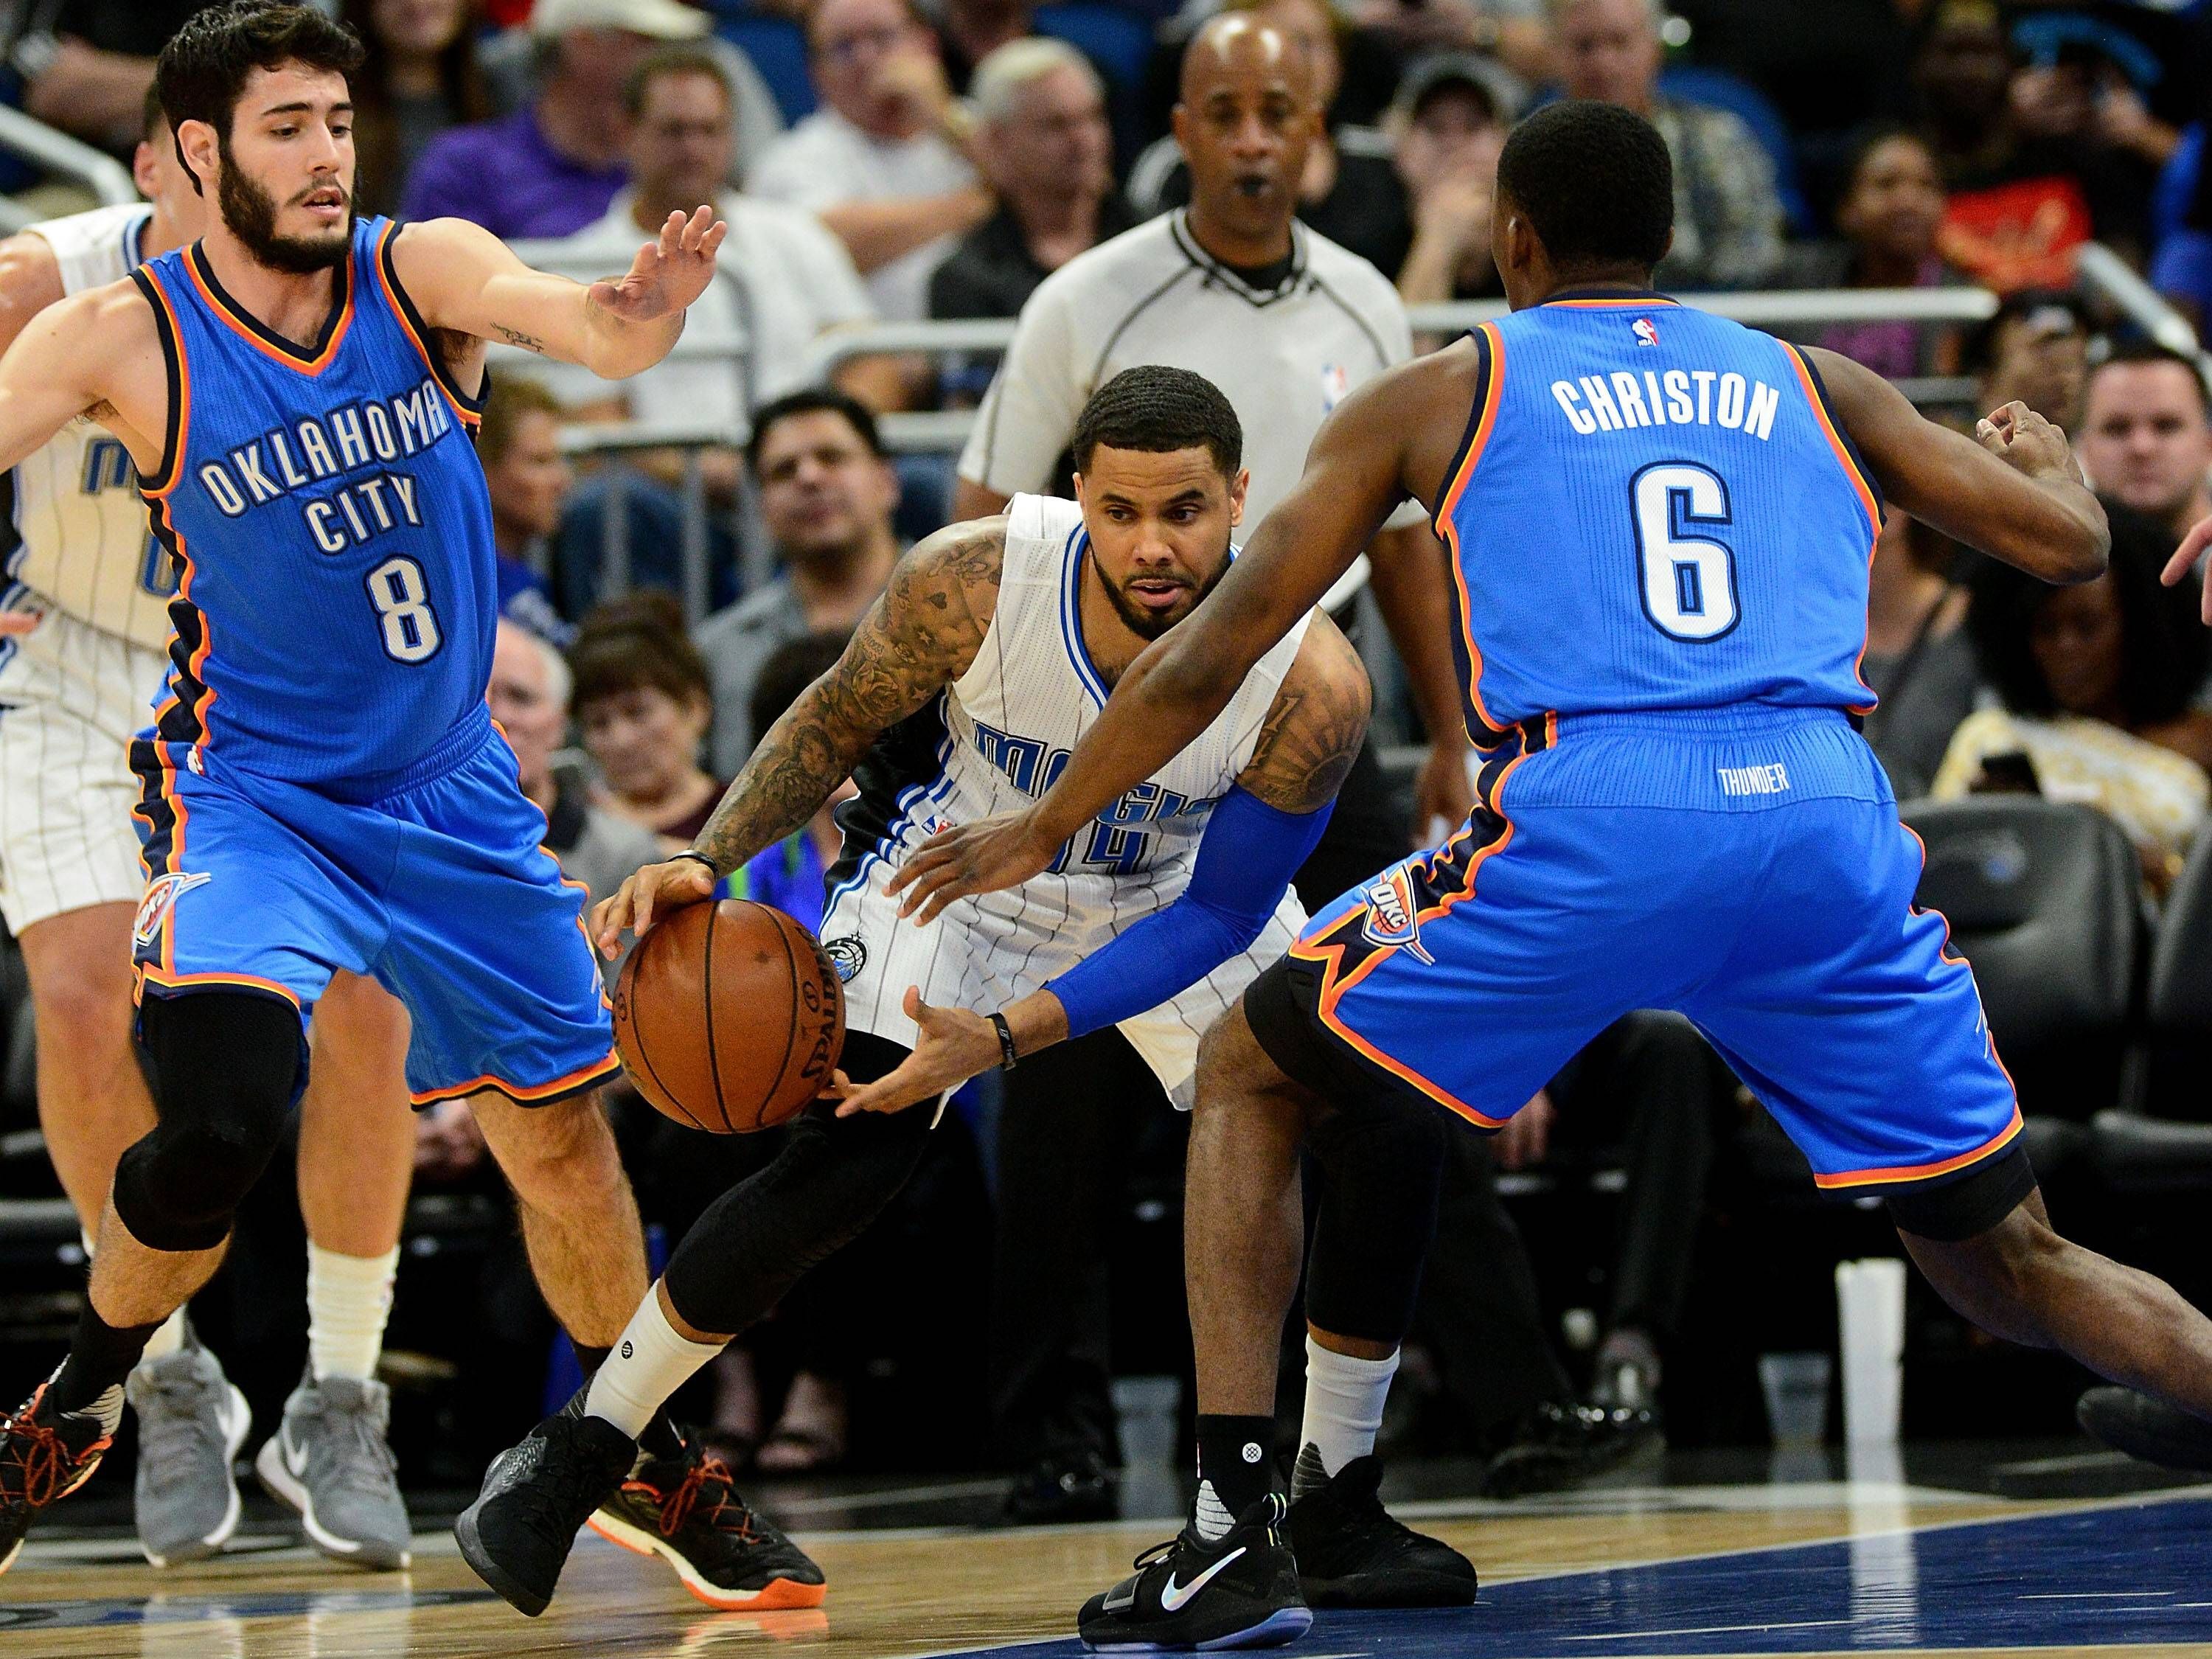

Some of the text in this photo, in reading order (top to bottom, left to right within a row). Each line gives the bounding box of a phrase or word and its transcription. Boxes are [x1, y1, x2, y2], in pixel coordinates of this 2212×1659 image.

[1551, 369, 1780, 441] CHRISTON
[198, 377, 448, 518] OKLAHOMA
[304, 471, 424, 555] CITY
[1630, 460, 1742, 644] 6
[366, 554, 442, 665] 8
[1718, 763, 1790, 796] THUNDER
[1369, 883, 1409, 928] OKC
